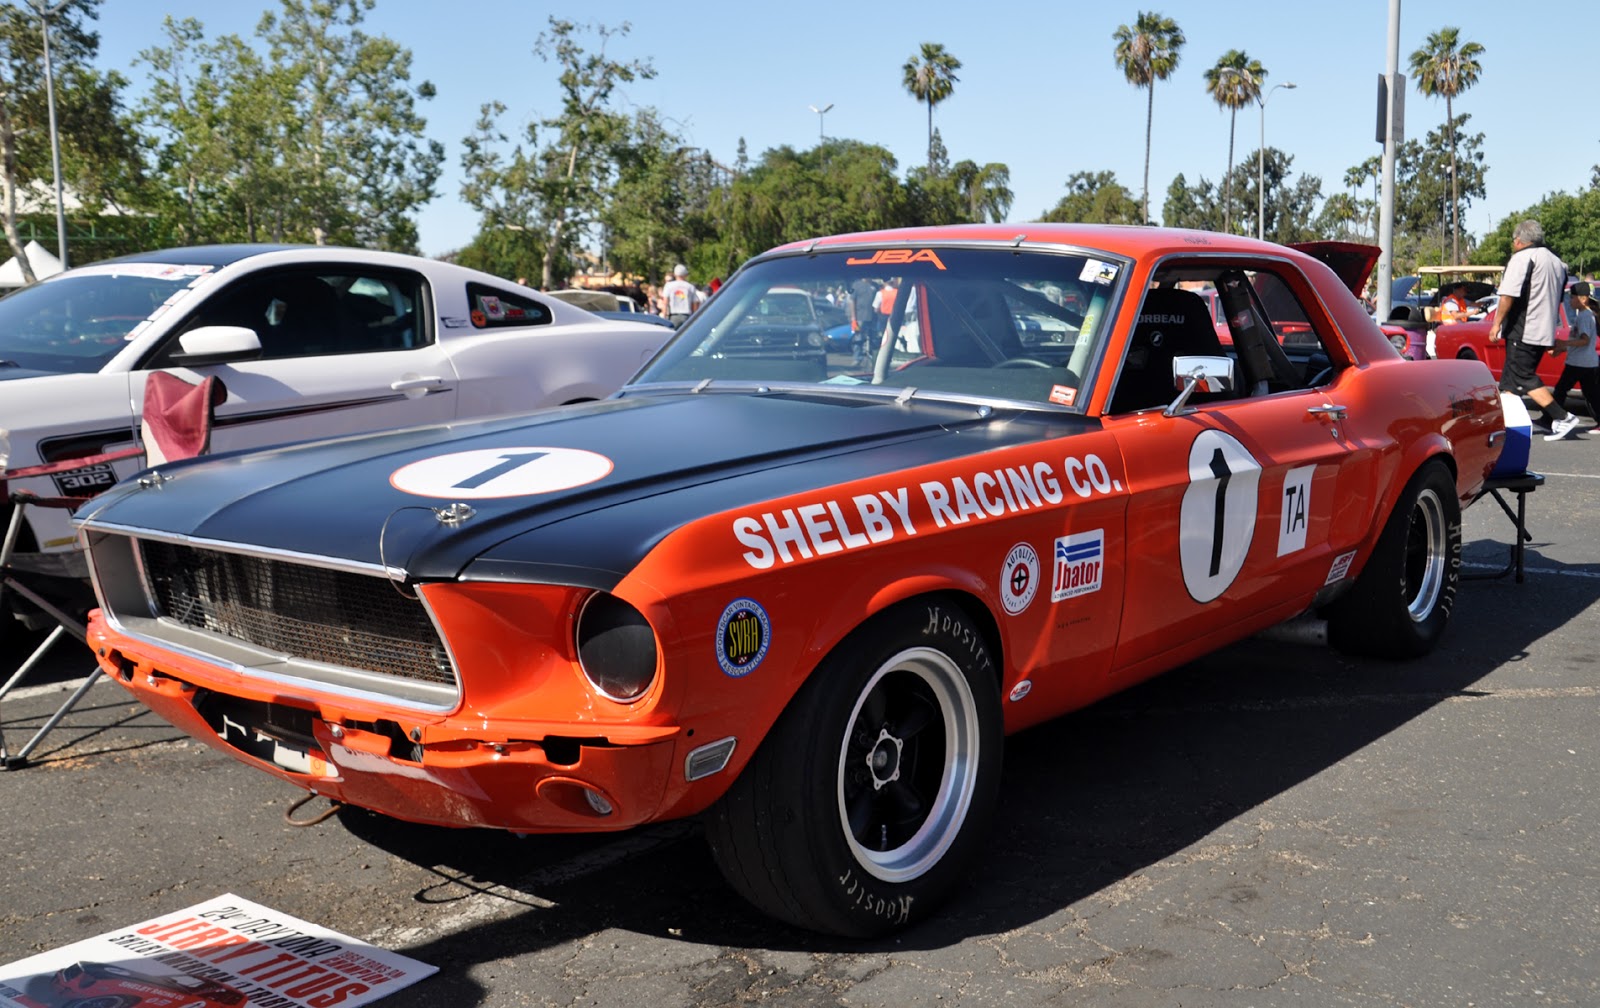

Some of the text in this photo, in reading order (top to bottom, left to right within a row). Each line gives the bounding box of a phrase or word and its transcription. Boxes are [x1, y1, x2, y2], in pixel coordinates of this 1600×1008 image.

[846, 249, 947, 270] JBA
[1138, 314, 1185, 324] ORBEAU
[61, 472, 112, 489] 302
[450, 452, 551, 489] 1
[732, 453, 1123, 569] SHELBY RACING CO.
[1209, 448, 1232, 577] 1
[1286, 484, 1305, 534] TA
[1006, 548, 1035, 569] AUTOLITE
[1054, 561, 1100, 592] Jbator
[1073, 583, 1099, 595] PERFORMANCE
[717, 601, 769, 658] SPORTSCAR VINTAGE RACING
[729, 616, 759, 658] SVRA
[723, 649, 765, 675] ASSOCIATION
[231, 918, 342, 959] DAYTONA
[108, 934, 170, 956] SHELBY
[152, 952, 238, 982] AMERICAN
[136, 917, 370, 1008] JERRY TITUS
[320, 957, 391, 986] CHAMPION
[358, 957, 391, 973] TRANS
[388, 968, 406, 979] AM
